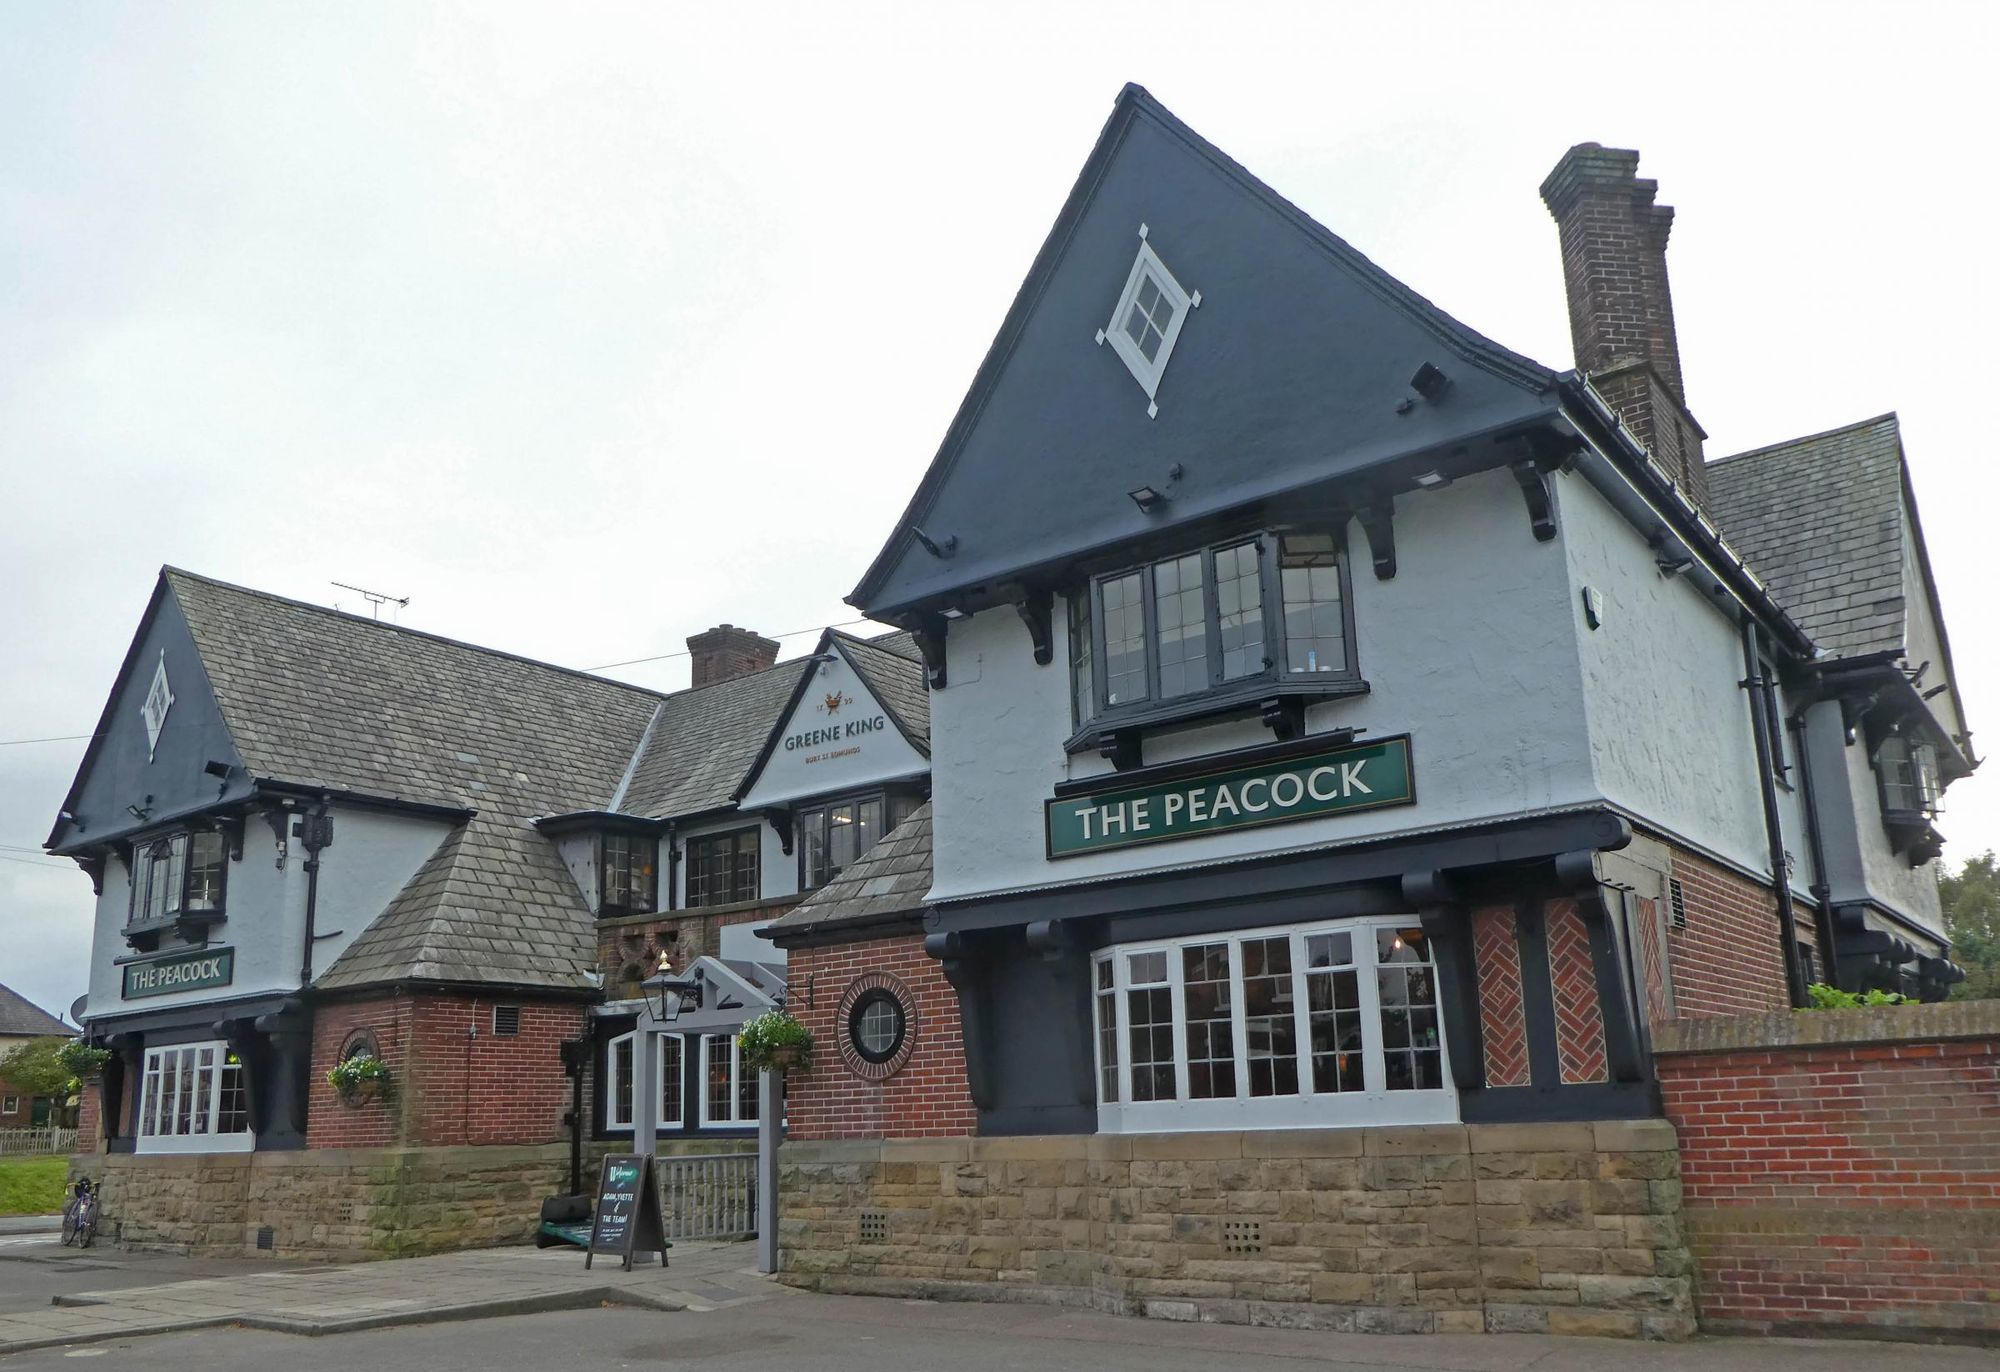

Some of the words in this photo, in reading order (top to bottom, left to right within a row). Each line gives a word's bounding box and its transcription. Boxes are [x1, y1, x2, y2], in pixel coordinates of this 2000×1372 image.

[785, 726, 840, 751] GREENE
[845, 715, 884, 737] KING
[1075, 798, 1151, 840] THE
[1164, 759, 1373, 826] PEACOCK
[132, 969, 156, 990] THE
[158, 958, 220, 986] PEACOCK
